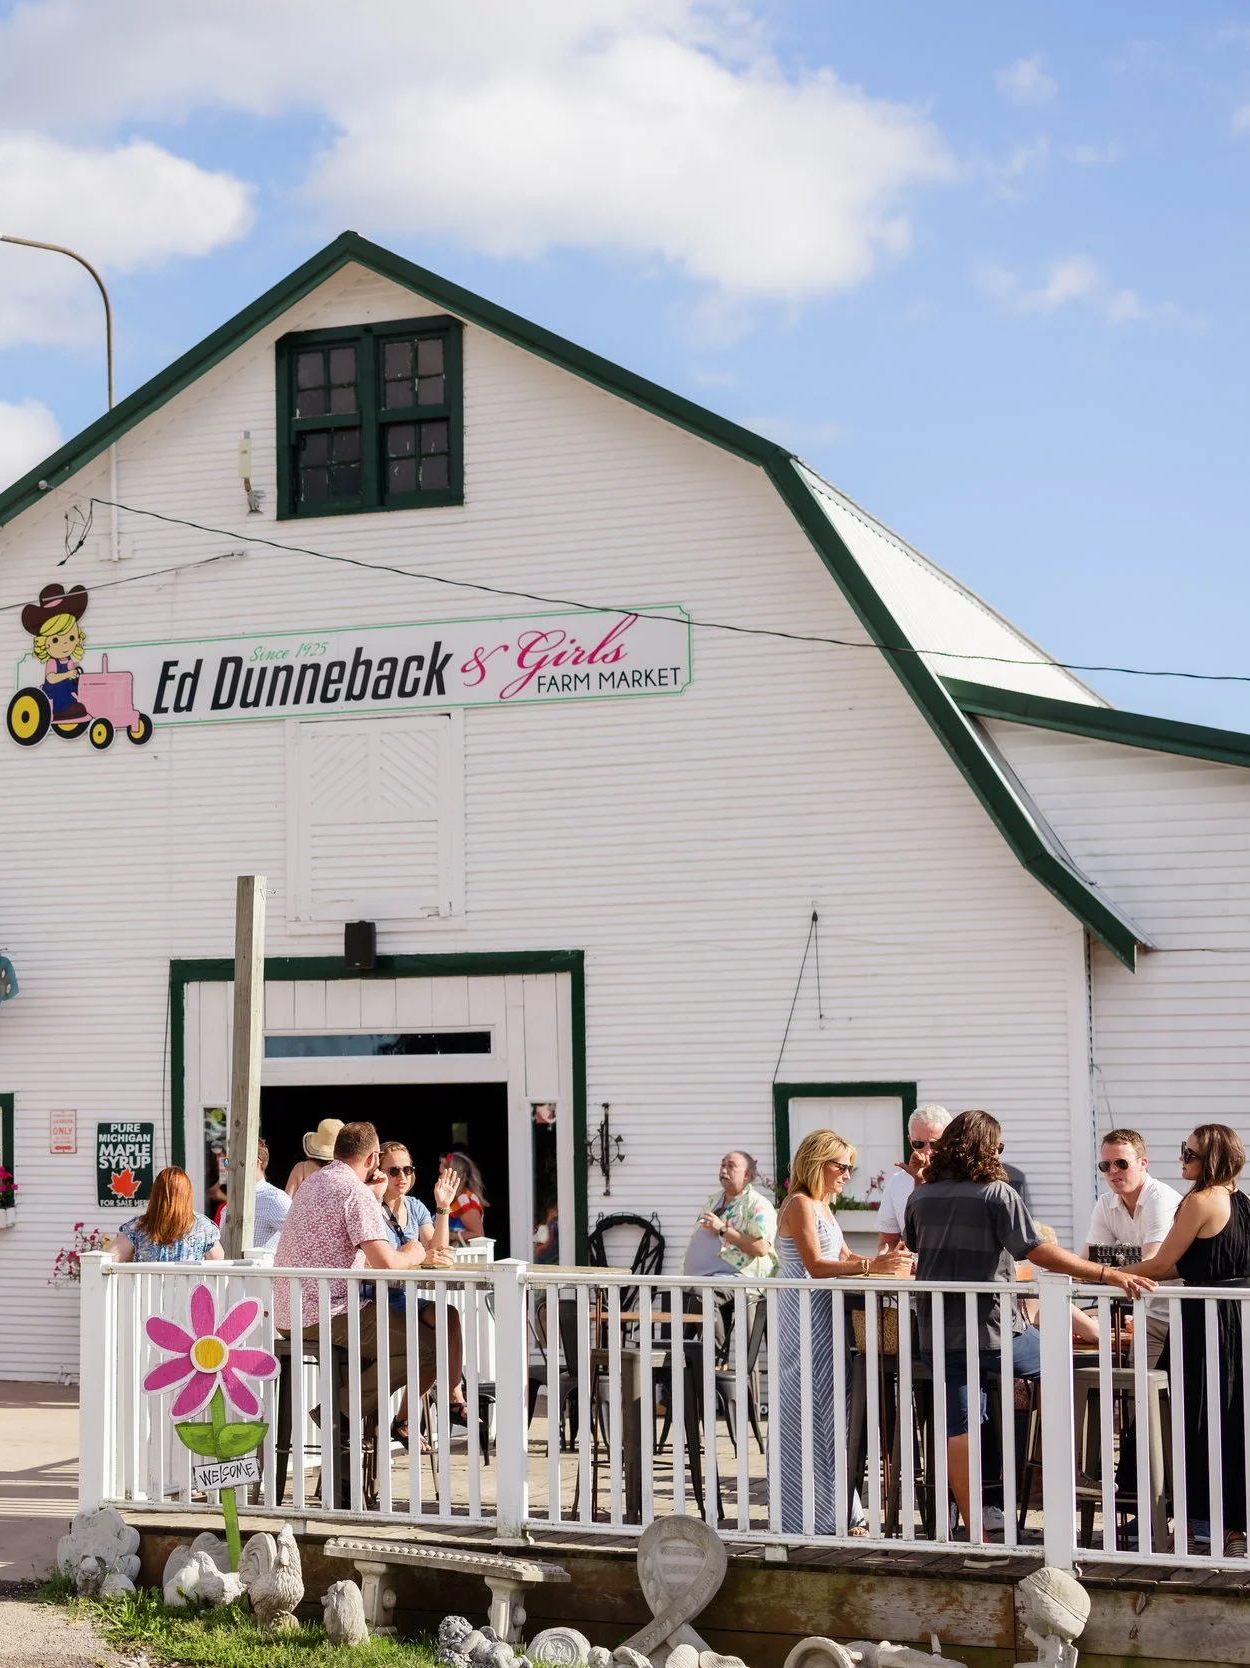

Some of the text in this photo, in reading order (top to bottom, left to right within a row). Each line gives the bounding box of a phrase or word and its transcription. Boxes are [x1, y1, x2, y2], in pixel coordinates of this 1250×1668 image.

[250, 641, 329, 662] Since 1925
[152, 612, 639, 714] Ed Dunneback & Girls
[537, 667, 681, 693] FARM MARKET
[52, 1127, 73, 1136] ONLY
[110, 1123, 141, 1133] PURE
[98, 1134, 151, 1143] MICHIGAN
[99, 1144, 151, 1156] MAPLE
[98, 1156, 151, 1169] SYRUP
[100, 1199, 150, 1207] FOR SALE HER
[199, 1462, 255, 1486] WELCOME
